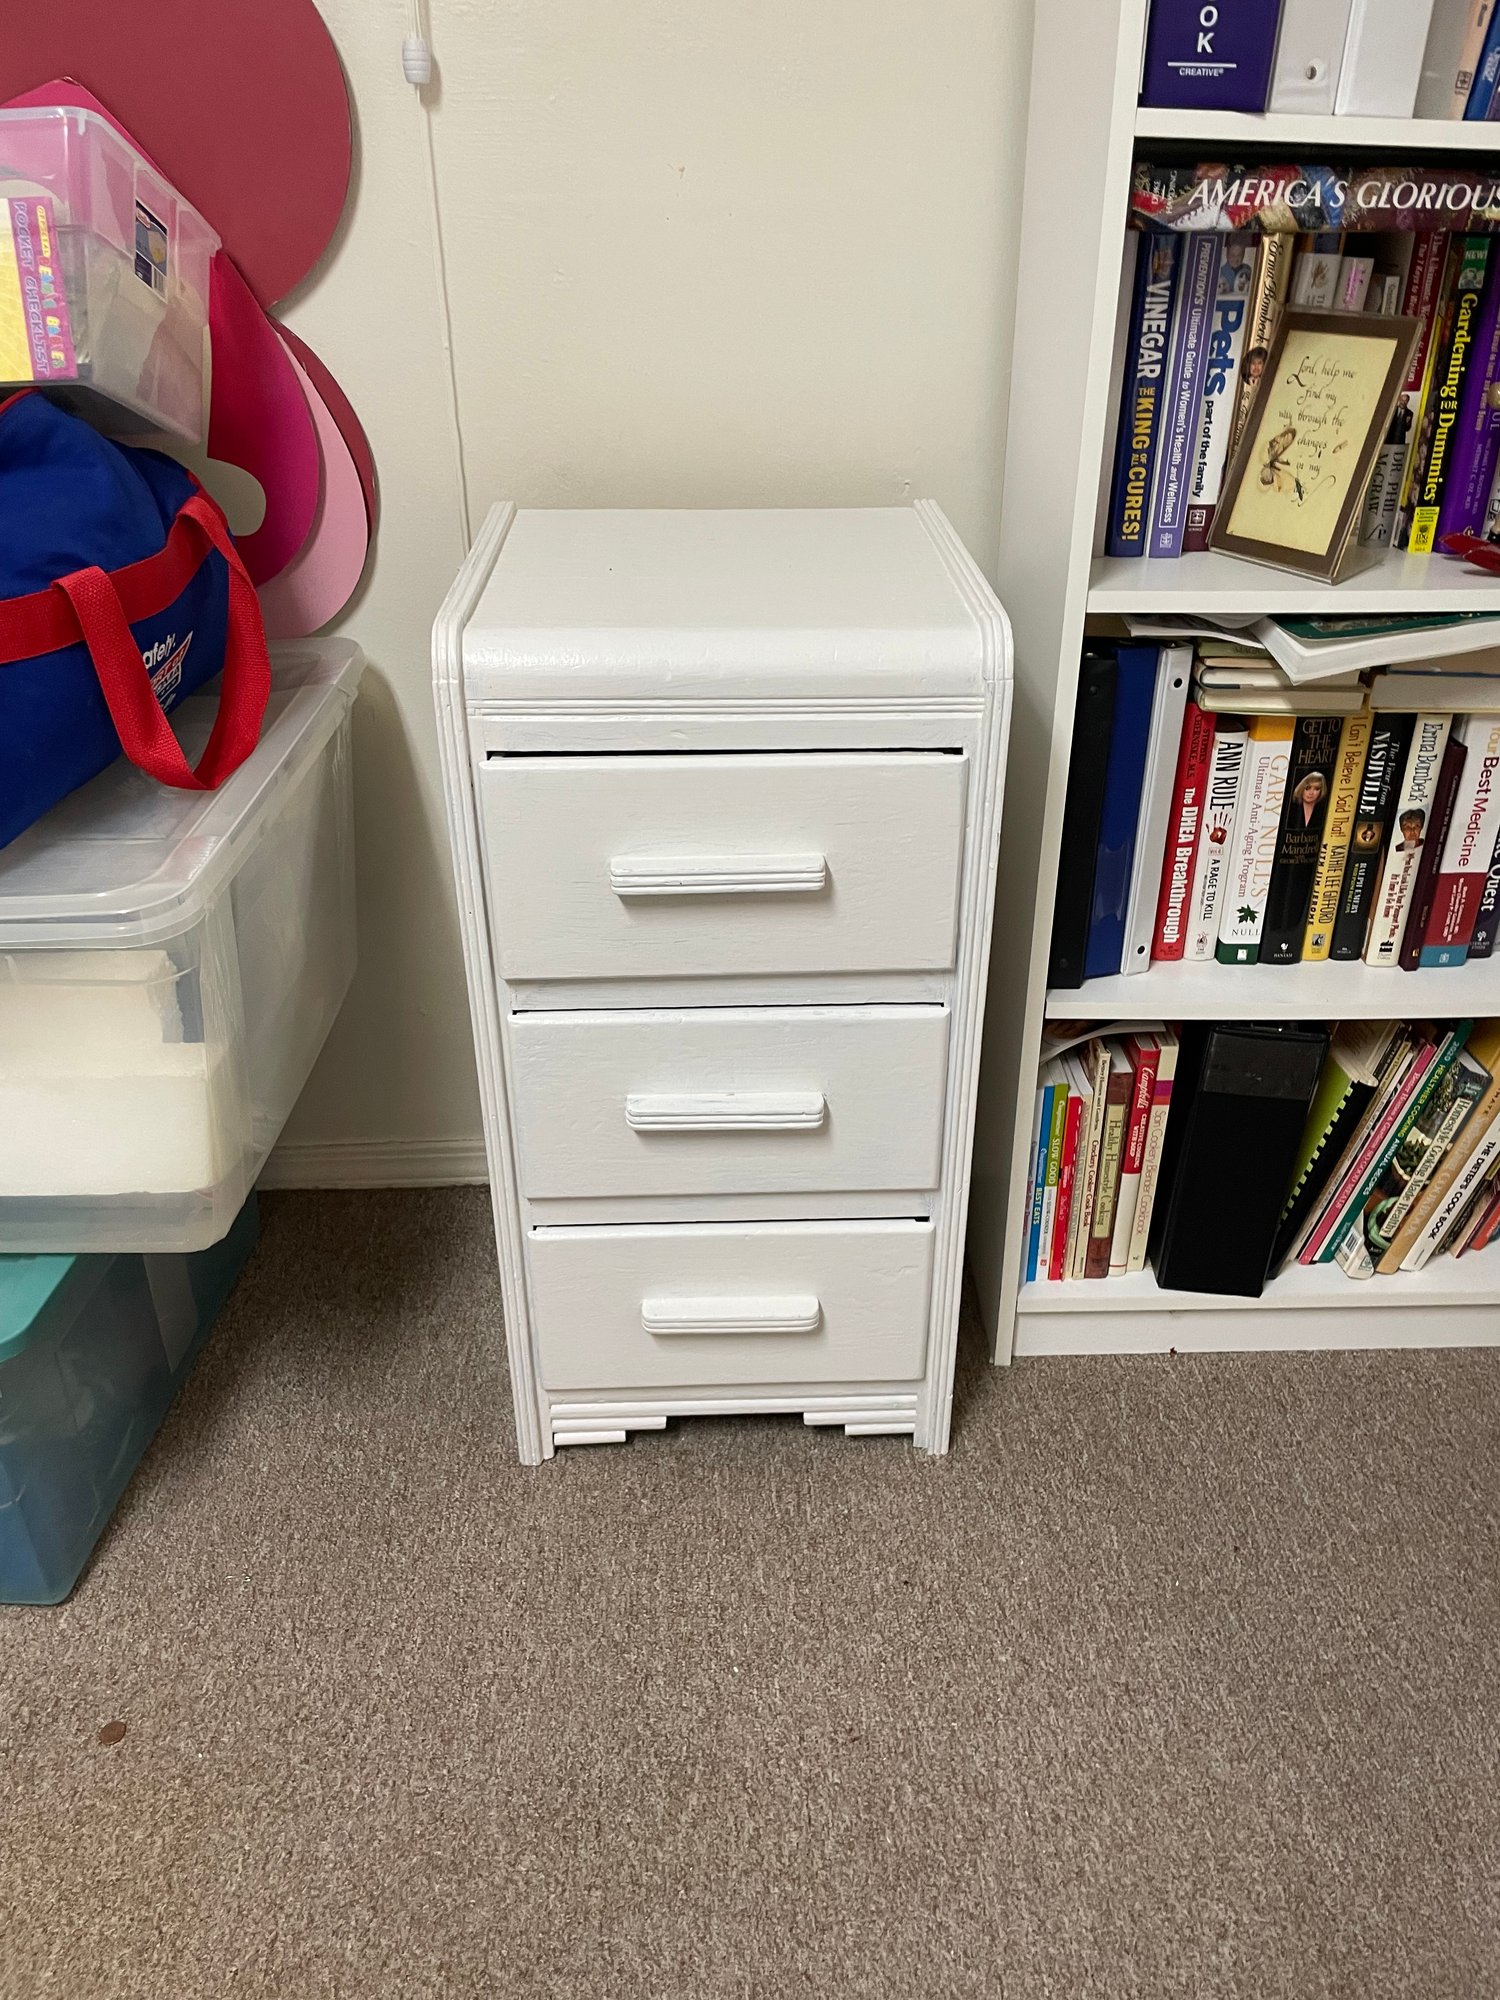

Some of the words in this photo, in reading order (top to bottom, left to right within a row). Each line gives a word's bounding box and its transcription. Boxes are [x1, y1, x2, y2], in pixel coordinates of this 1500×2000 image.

[1188, 176, 1349, 208] AMERICA'S
[1266, 240, 1283, 279] Erma
[1466, 250, 1488, 260] NEW!
[14, 202, 34, 271] POCKET
[25, 276, 48, 374] CHECKLIST
[1193, 242, 1212, 305] PREVENTION'S
[1187, 307, 1201, 349] Ultimate
[1256, 281, 1277, 346] Bombeck
[1136, 280, 1170, 379] VINEGAR
[1203, 301, 1246, 398] Pets
[1440, 293, 1479, 398] Gardening
[1183, 351, 1197, 379] Guide
[1138, 387, 1156, 396] THE
[1182, 381, 1188, 390] to
[1176, 390, 1191, 433] Women's
[1203, 400, 1214, 428] part
[1440, 401, 1458, 410] FOR
[1132, 398, 1155, 450] KING
[1202, 428, 1212, 440] of
[1172, 434, 1184, 465] Health
[1199, 440, 1210, 460] the
[1390, 452, 1404, 477] DR.
[1424, 413, 1456, 504] Dummies
[1170, 467, 1178, 482] and
[1192, 462, 1207, 498] family
[1368, 454, 1388, 516] McGRAW
[1122, 466, 1146, 540] CURES!
[1164, 481, 1178, 523] Wellness
[1382, 482, 1398, 518] PHIL
[142, 632, 176, 670] afety!
[1302, 719, 1325, 734] GET
[1327, 718, 1342, 732] TO
[1347, 723, 1367, 747] Can't
[1420, 722, 1444, 753] Erma
[1215, 741, 1244, 772] ANN
[1298, 749, 1335, 764] HEART
[1309, 734, 1332, 750] THE
[1390, 741, 1400, 760] The
[1252, 756, 1271, 799] Ultimate
[1340, 751, 1362, 784] Believe
[1360, 730, 1391, 815] NASHVILLE
[1408, 754, 1438, 803] Bombeck
[1476, 757, 1499, 794] Best
[1184, 787, 1196, 805] The
[1210, 776, 1238, 811] RULE
[1264, 754, 1289, 816] GARY
[1380, 782, 1392, 806] from
[1334, 794, 1354, 814] Said
[1178, 806, 1198, 843] DHEA
[1242, 801, 1261, 856] Anti-Aging
[1330, 816, 1350, 838] That!
[1458, 798, 1489, 867] Medicine
[1318, 843, 1328, 867] WITH
[1326, 844, 1347, 873] KATHIE
[1208, 866, 1220, 890] RAGE
[1238, 858, 1254, 898] Program
[1315, 871, 1323, 886] JIM
[1324, 875, 1342, 888] LEE
[1356, 862, 1368, 888] RALPH
[1480, 864, 1500, 912] Quest
[1163, 847, 1192, 944] Breakthrough
[1206, 890, 1216, 902] TO
[1308, 890, 1320, 926] JEROME
[1318, 890, 1339, 924] GIFFORD
[1350, 888, 1362, 914] EMERY
[1203, 903, 1214, 921] KILL
[1442, 1040, 1459, 1062] 2020
[1416, 1062, 1445, 1105] HEALTHIER
[1104, 1119, 1121, 1152] Healthy
[1132, 1125, 1140, 1142] WITH
[1139, 1112, 1148, 1142] CREATIVE
[1396, 1103, 1421, 1138] COOKING
[1434, 1097, 1469, 1146] Homestyle
[1051, 1138, 1061, 1161] SLOW
[1088, 1139, 1098, 1168] Crockery
[1129, 1142, 1137, 1158] SOUP
[1134, 1143, 1144, 1169] COOKING
[1148, 1128, 1164, 1166] Cookery
[1378, 1137, 1400, 1168] ANNUAL
[1414, 1142, 1443, 1179] Cooking
[1480, 1138, 1496, 1158] THE
[1048, 1162, 1058, 1184] GOOD
[1085, 1169, 1095, 1192] Cooker
[1361, 1166, 1383, 1196] RECIPES
[1458, 1155, 1485, 1192] DIETER'S
[1084, 1192, 1092, 1210] Cook
[1401, 1175, 1423, 1203] Made
[1442, 1189, 1463, 1216] COOK
[1033, 1206, 1041, 1225] EATS
[1082, 1210, 1090, 1227] Book
[1096, 1194, 1111, 1226] Cooking
[1136, 1195, 1152, 1235] Cookbook
[1380, 1199, 1408, 1236] Healthy
[1426, 1214, 1447, 1241] BOOK
